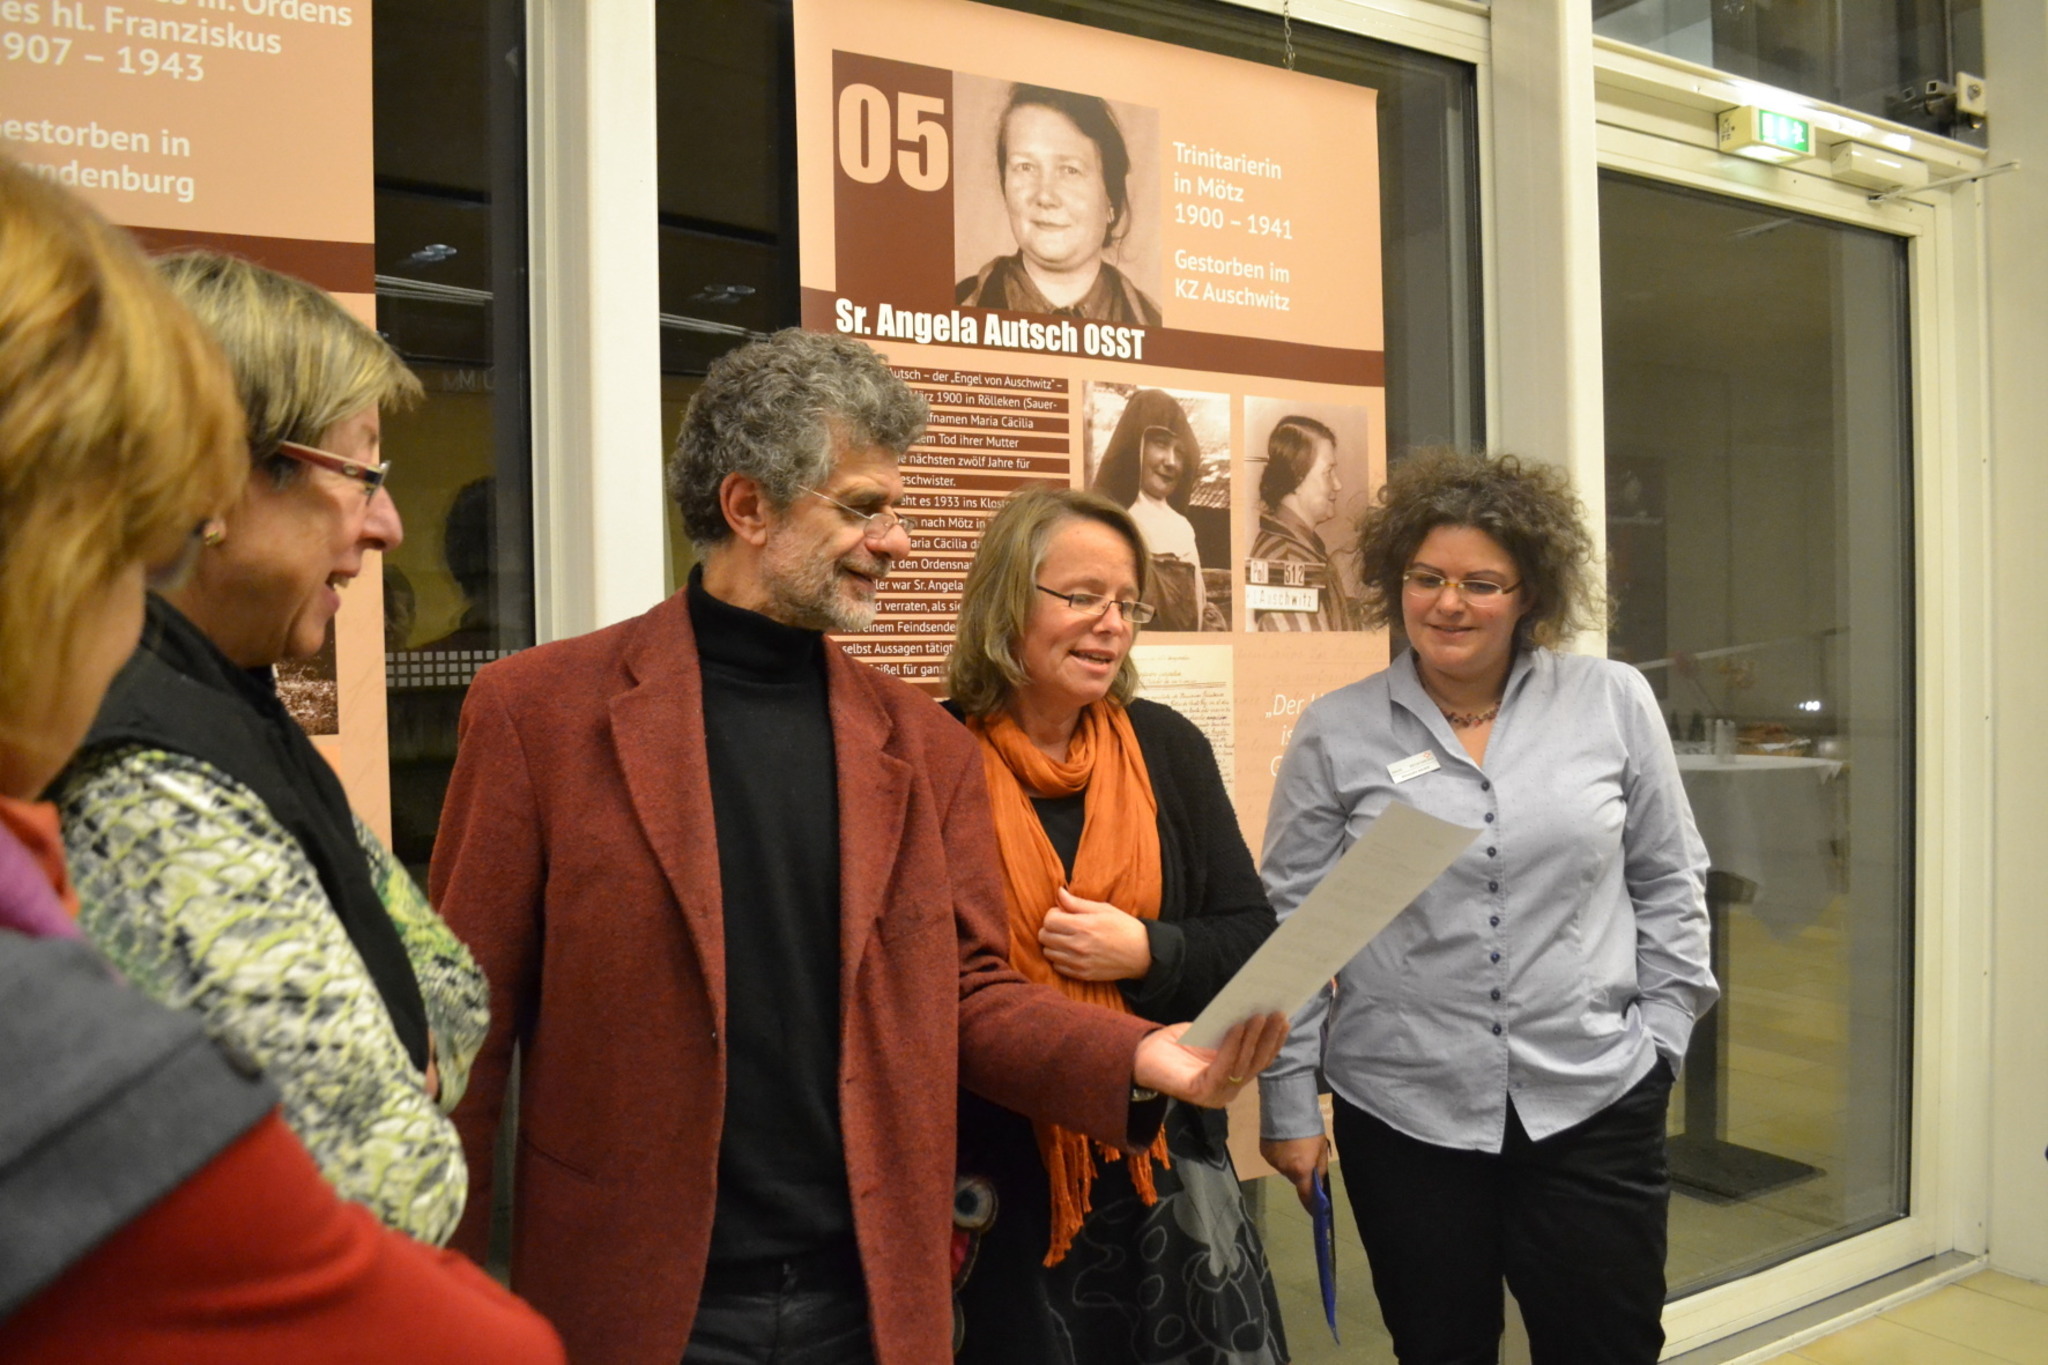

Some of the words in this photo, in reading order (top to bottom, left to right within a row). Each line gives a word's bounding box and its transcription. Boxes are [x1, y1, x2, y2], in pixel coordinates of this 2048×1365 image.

[1, 0, 40, 24] es
[52, 0, 96, 31] hl.
[105, 6, 282, 54] Franziskus
[2, 31, 73, 65] 907
[117, 46, 205, 82] 1943
[0, 119, 149, 153] estorben
[161, 129, 190, 157] in
[838, 83, 949, 192] 05
[1172, 141, 1283, 180] Trinitarierin
[1174, 171, 1191, 194] in
[1197, 175, 1244, 202] Mötz
[1175, 202, 1224, 229] 1900
[1247, 213, 1293, 239] 1941
[1174, 248, 1264, 280] Gestorben
[1269, 261, 1290, 283] im
[1175, 277, 1199, 299] KZ
[1202, 281, 1290, 311] Auschwitz
[835, 298, 871, 335] Sr.
[876, 303, 978, 345] Angela
[983, 313, 1078, 353] Autsch
[1083, 323, 1146, 360] OSST
[932, 371, 949, 382] der
[985, 377, 1002, 385] von
[937, 392, 962, 403] 1900
[965, 393, 975, 404] in
[978, 394, 1020, 408] Rölleken
[1023, 398, 1058, 410] (Sauer-
[971, 416, 998, 427] Maria
[1002, 417, 1034, 429] Cäcilia
[918, 434, 936, 444] em
[938, 433, 956, 445] Tod
[960, 434, 983, 446] ihrer
[986, 437, 1019, 448] Mutter
[910, 453, 955, 466] nächsten
[958, 456, 985, 467] zwölf
[988, 457, 1013, 468] Jahre
[1016, 458, 1030, 469] für
[902, 474, 956, 487] eschwister.
[901, 496, 916, 506] eht
[920, 498, 931, 507] es
[934, 496, 959, 507] 1933
[963, 496, 978, 508] ins
[921, 517, 945, 528] nach
[948, 518, 974, 529] Mötz
[976, 518, 986, 528] in
[934, 537, 967, 549] Cäcilia
[899, 559, 918, 569] den
[891, 581, 911, 590] war
[914, 579, 927, 591] Sr.
[928, 579, 964, 594] Angela
[884, 602, 930, 613] verraten,
[931, 601, 946, 611] als
[874, 643, 922, 656] Aussagen
[903, 664, 917, 675] für
